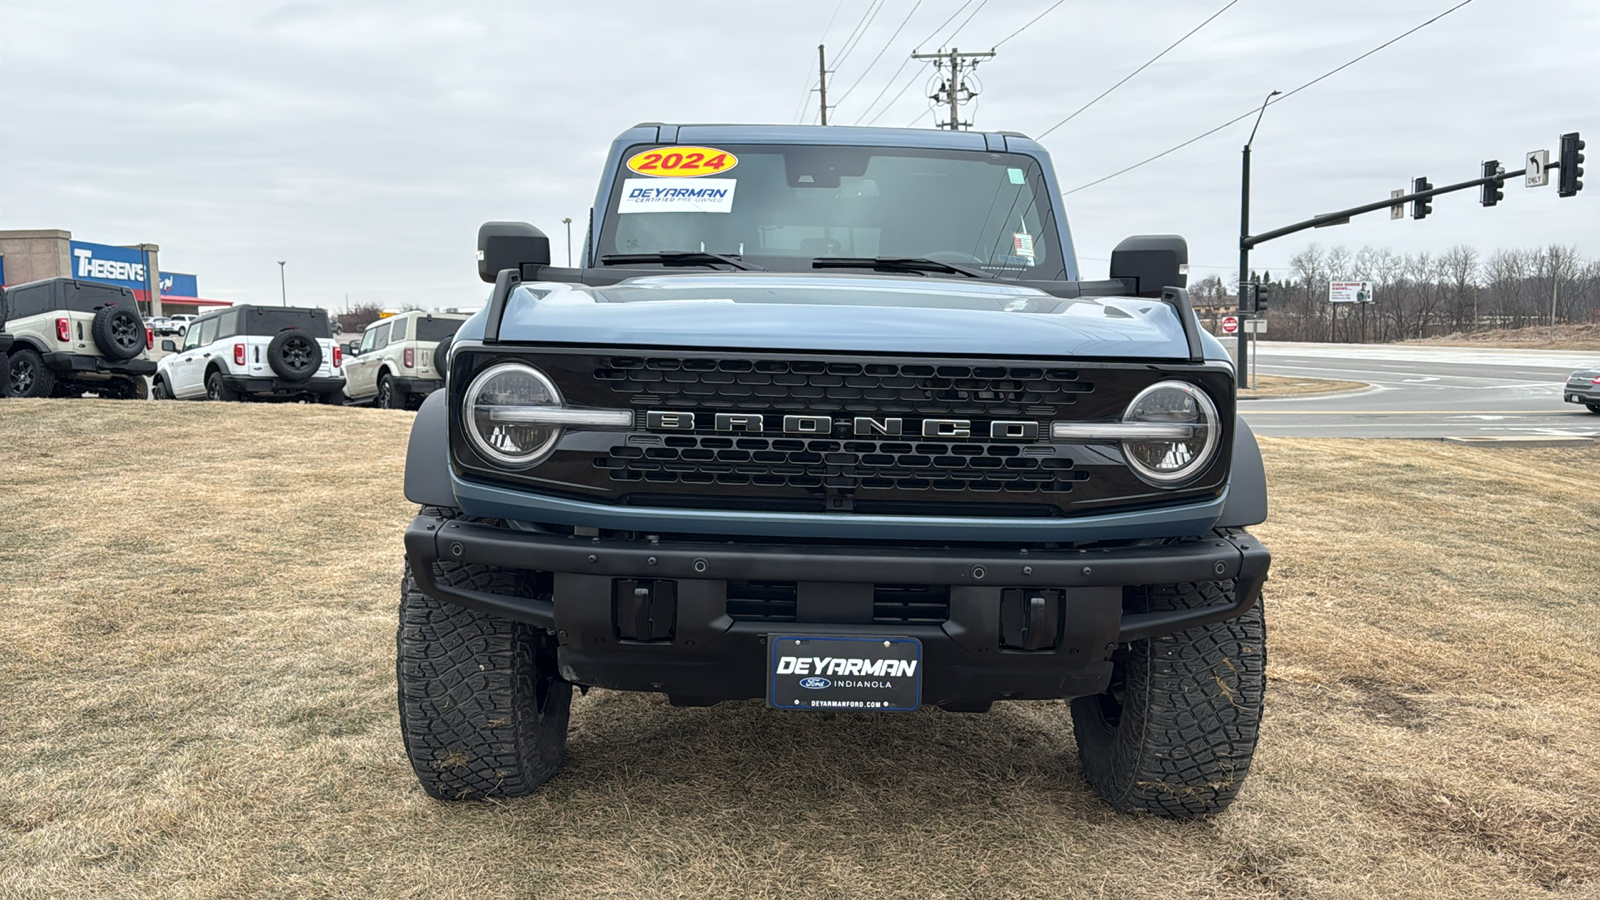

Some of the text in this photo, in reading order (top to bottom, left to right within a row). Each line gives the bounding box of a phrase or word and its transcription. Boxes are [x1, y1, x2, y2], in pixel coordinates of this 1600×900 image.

[637, 153, 728, 171] 2024
[1528, 176, 1541, 184] ONLY
[628, 188, 728, 198] DEYARMAN
[74, 248, 147, 282] THEISEN'S
[646, 409, 1040, 440] BRONCO
[776, 656, 918, 677] DEYARMAN
[834, 680, 892, 689] INDIANOLA
[811, 700, 881, 709] DEYARMANFORD.COM
